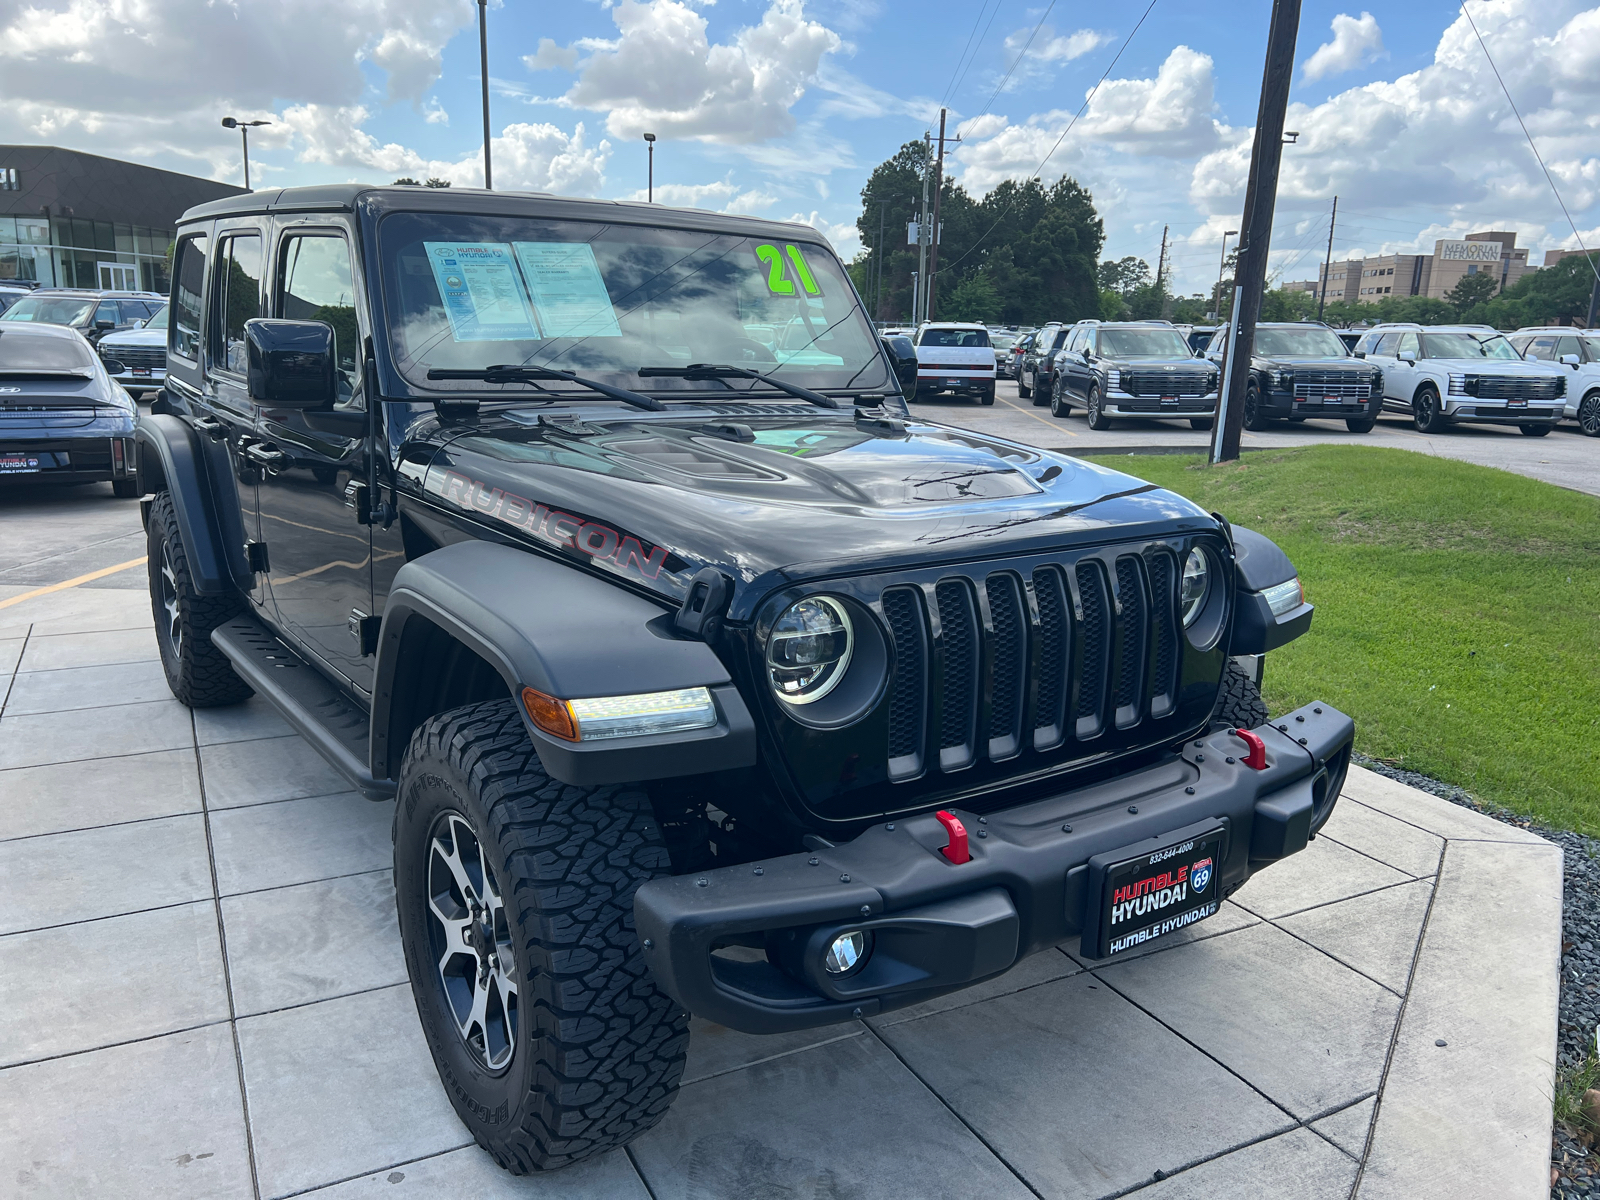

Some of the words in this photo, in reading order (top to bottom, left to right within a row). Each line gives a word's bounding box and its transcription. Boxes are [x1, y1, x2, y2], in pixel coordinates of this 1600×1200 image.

[1443, 250, 1499, 261] HERMANN
[1445, 243, 1499, 254] MEMORIAL
[755, 244, 820, 296] 21
[440, 470, 669, 580] RUBICON
[1149, 841, 1194, 865] 832-644-4000
[1113, 865, 1188, 904] HUMBLE
[1194, 869, 1209, 888] 69
[1111, 882, 1187, 925] HYUNDAI
[1110, 926, 1160, 954] HUMBLE
[1161, 905, 1209, 934] HYUNDAI
